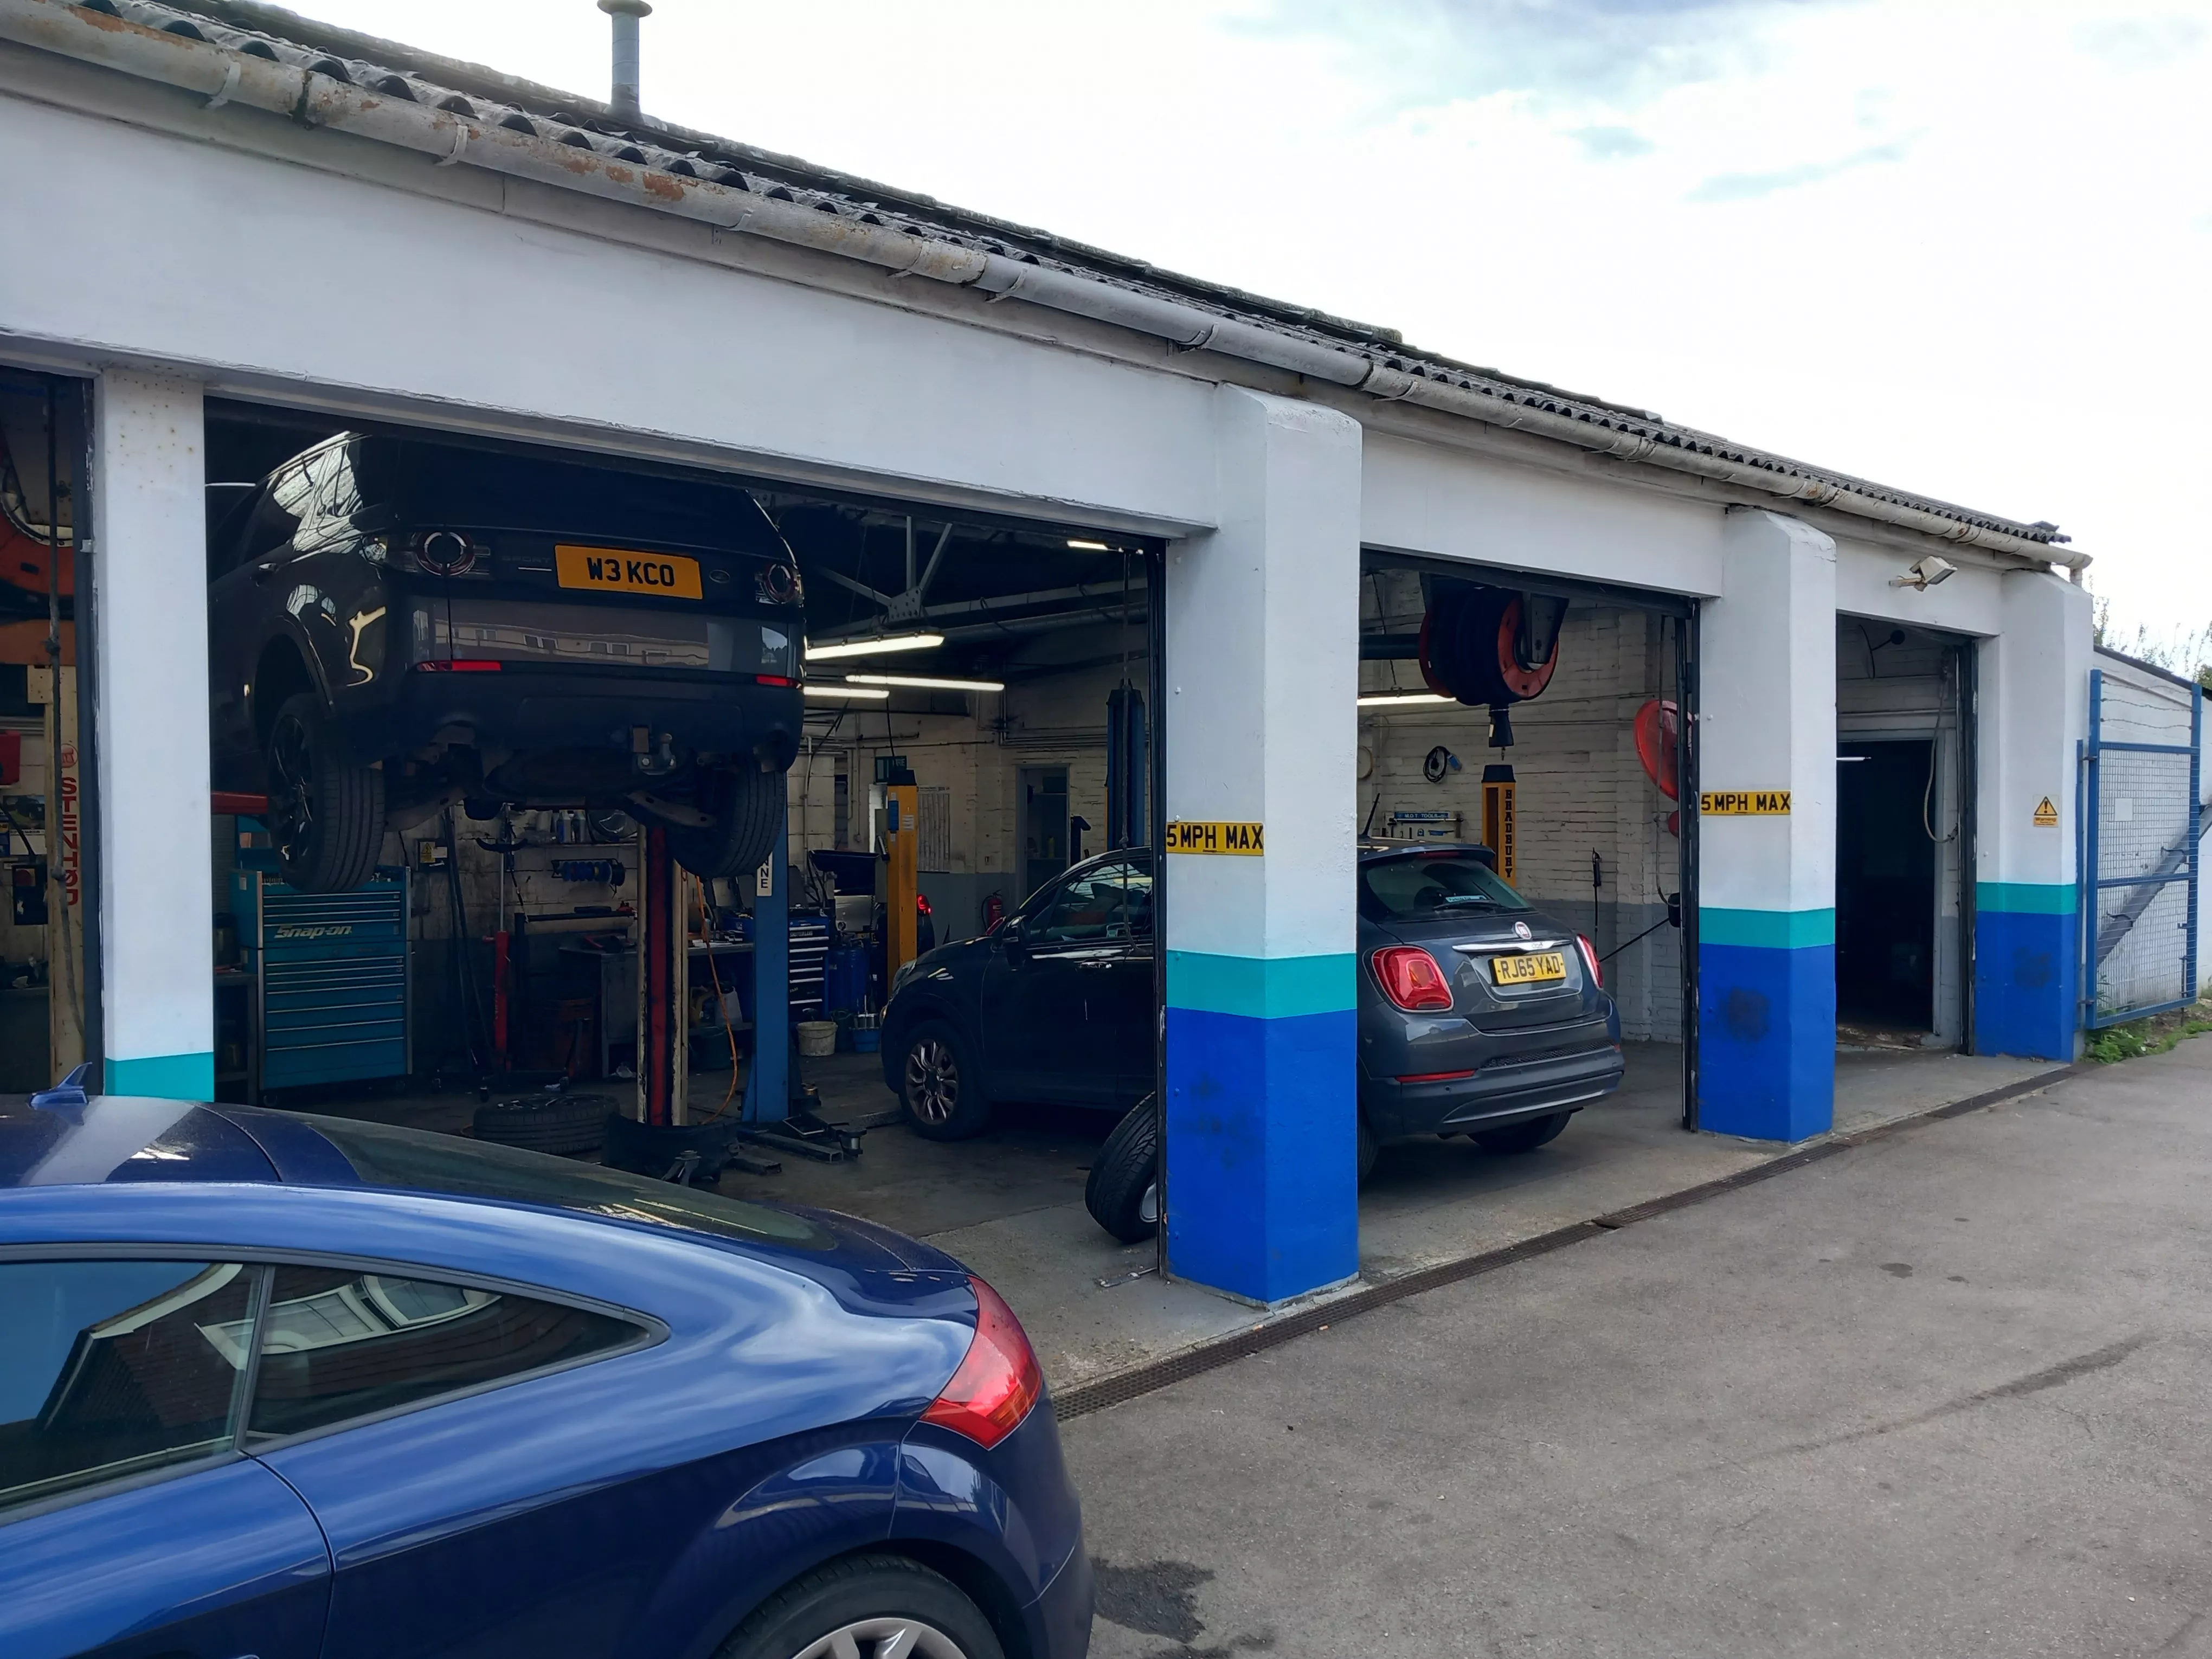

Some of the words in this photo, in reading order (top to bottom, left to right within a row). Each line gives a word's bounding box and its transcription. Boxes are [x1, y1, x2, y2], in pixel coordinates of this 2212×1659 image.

[501, 555, 551, 564] SPORT
[587, 557, 621, 582] W3
[626, 560, 675, 587] KCO
[1756, 793, 1791, 811] MAX
[1225, 825, 1263, 850] MAX
[1504, 789, 1513, 878] BRADBURY
[273, 923, 352, 940] Snap-on
[1500, 957, 1535, 979] RJ65
[1535, 955, 1561, 975] YAD
